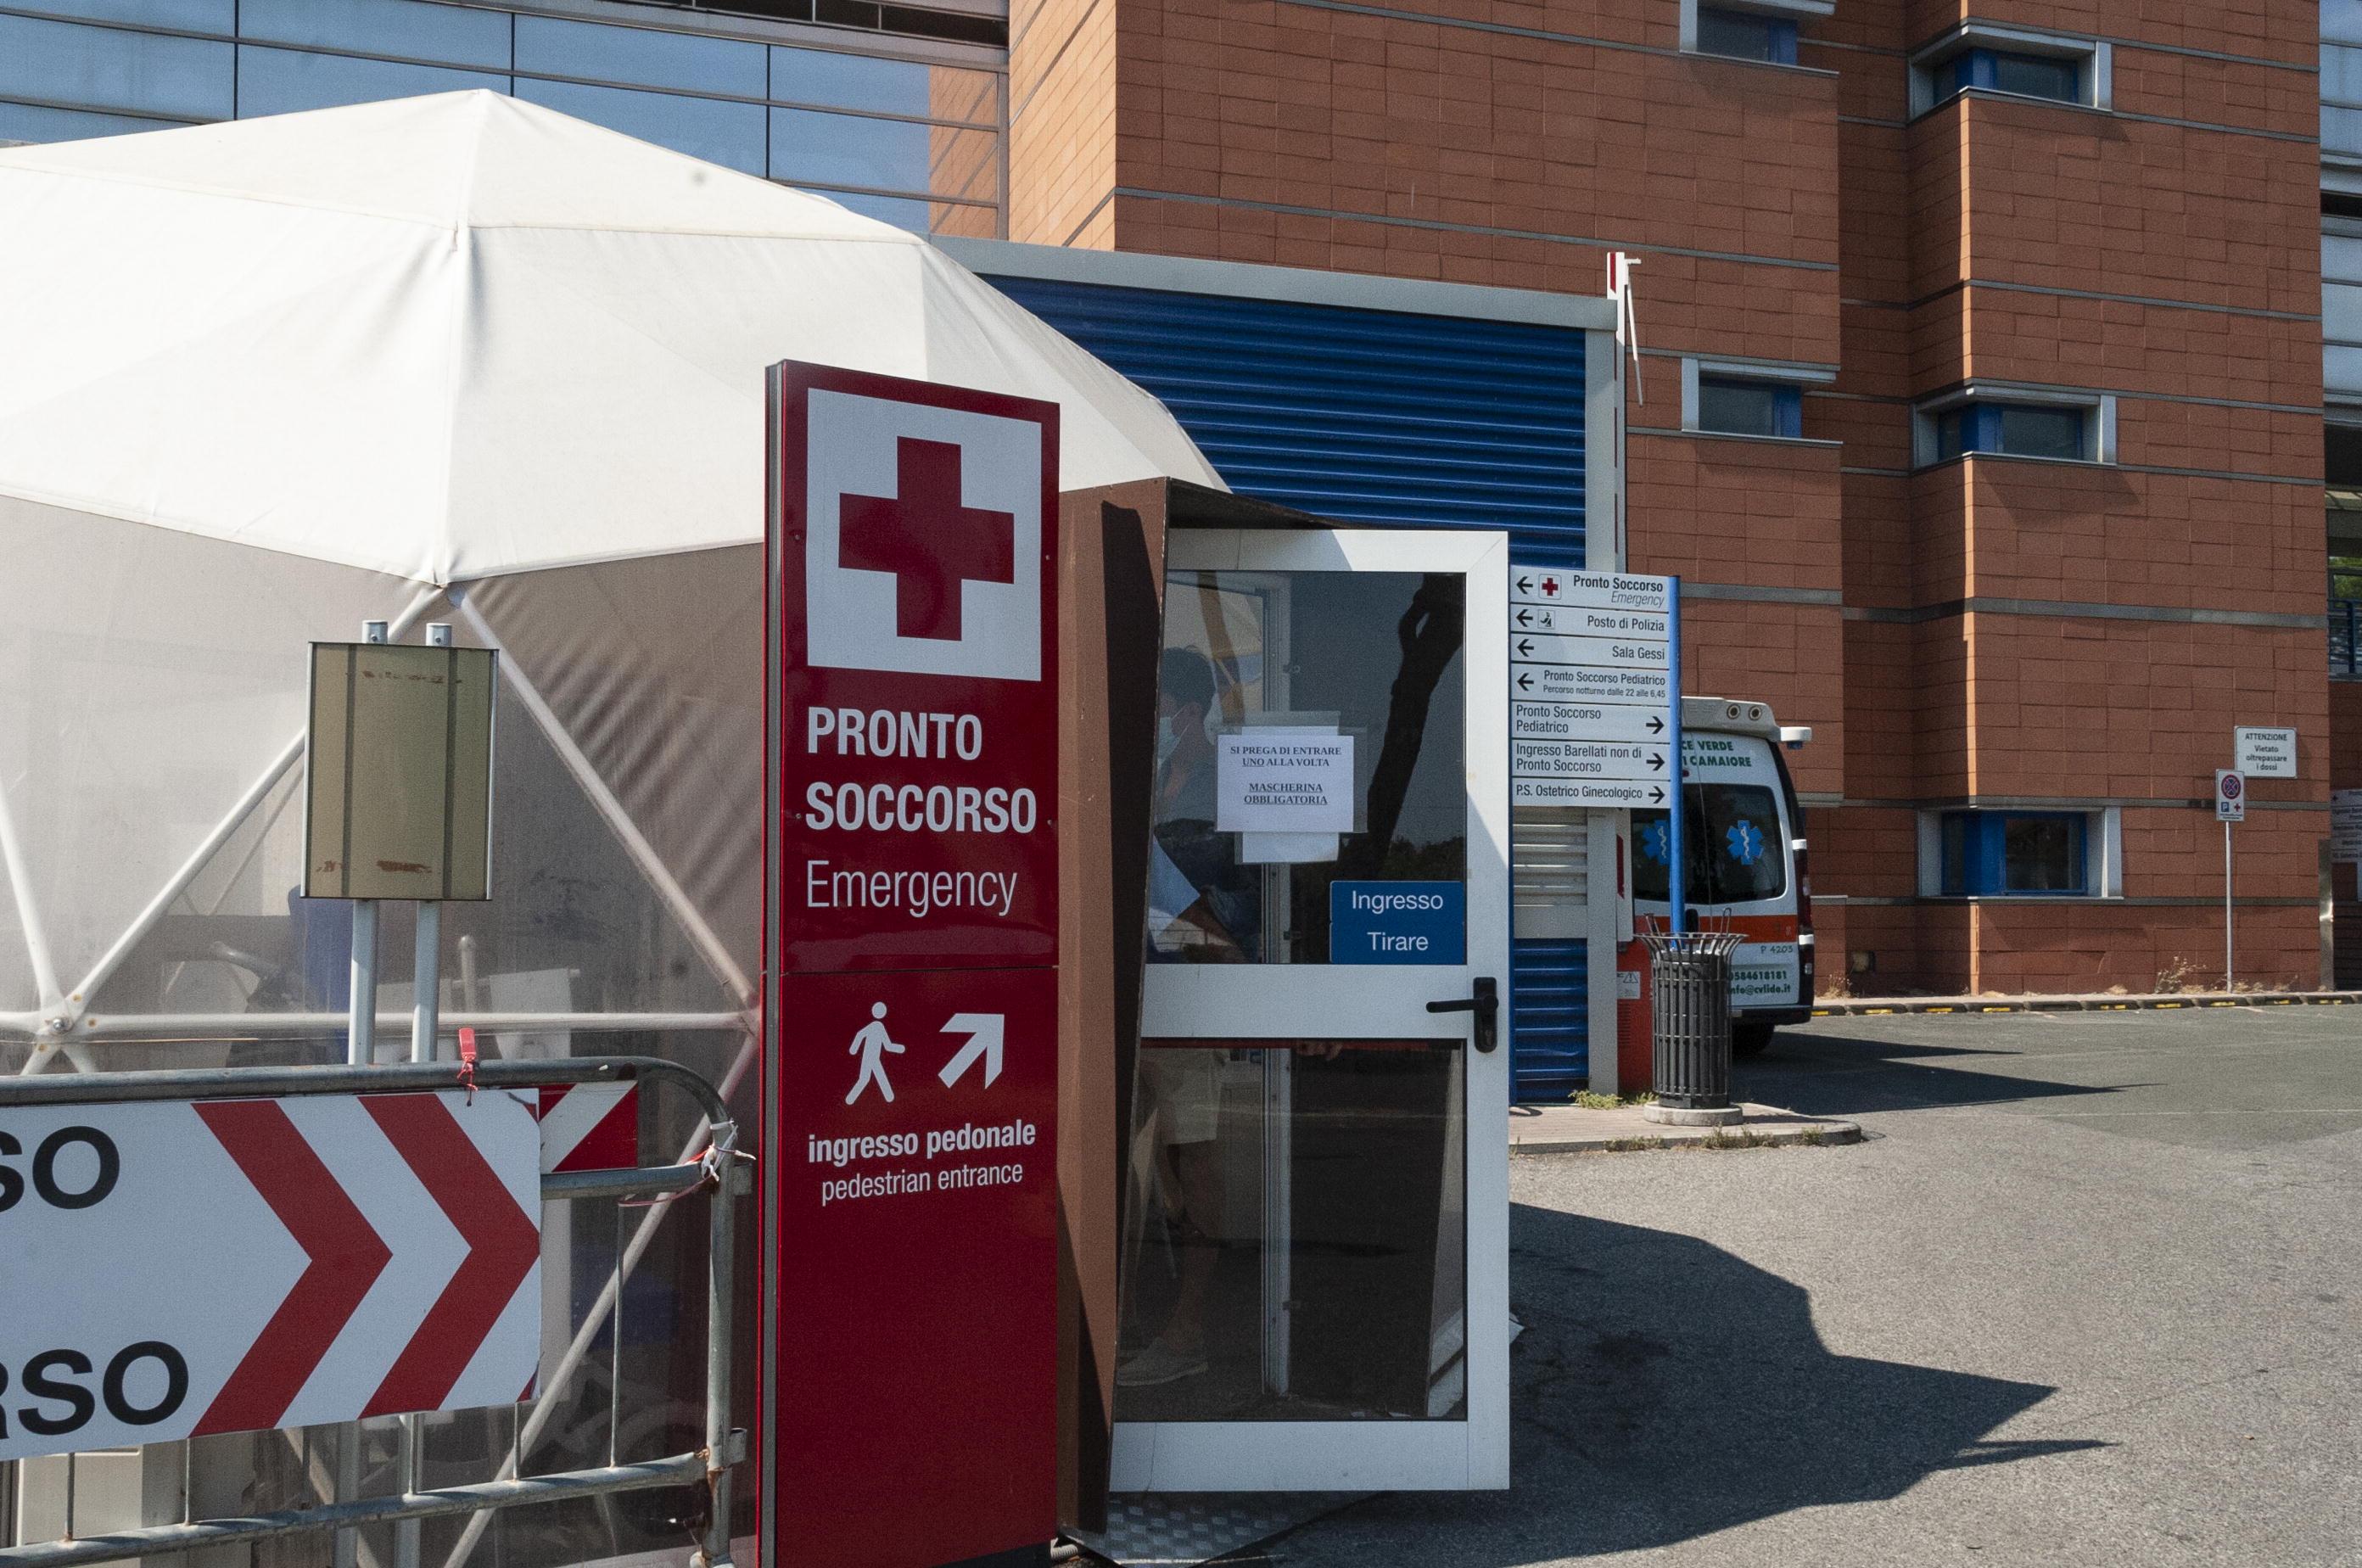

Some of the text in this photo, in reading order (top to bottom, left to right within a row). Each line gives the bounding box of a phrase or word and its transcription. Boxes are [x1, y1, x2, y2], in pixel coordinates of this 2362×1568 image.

[1573, 575, 1663, 592] Pronto Soccorso
[1611, 591, 1665, 608] Emergency
[1587, 616, 1665, 631] Posto di Polizia
[1613, 646, 1665, 660] Sala Gessi
[1544, 670, 1665, 686] Pronto Soccorso Pediatrico
[1543, 685, 1665, 698] Percorso notturno dalle 22 alle 6,45
[1516, 705, 1601, 719] Pronto Soccorso
[808, 707, 982, 760] PRONTO
[1516, 720, 1569, 733] Pediatrico
[1230, 746, 1341, 755] SI PREGA DI ENTRARE
[1516, 743, 1642, 759] Ingresso Barellati non di
[1698, 741, 1733, 751] VERDE
[1242, 758, 1329, 767] UNO ALLA VOLTA
[1516, 759, 1601, 772] Pronto Soccorso
[1690, 756, 1751, 767] CAMAIORE
[1249, 783, 1323, 792] MASCHERINA
[1516, 785, 1643, 800] P.S. Ostetrico Ginecologico
[806, 781, 1036, 833] SOCCORSO
[1244, 795, 1328, 805] OBBLIGATORIA
[807, 860, 1017, 917] Emergency
[1352, 891, 1443, 915] Ingresso
[1368, 932, 1428, 951] Tirare
[1730, 983, 1791, 995] nfo@cvlido.it
[809, 1119, 1036, 1168] ingresso pedonale
[822, 1163, 1023, 1207] pedestrian entrance
[0, 1340, 189, 1439] SO
